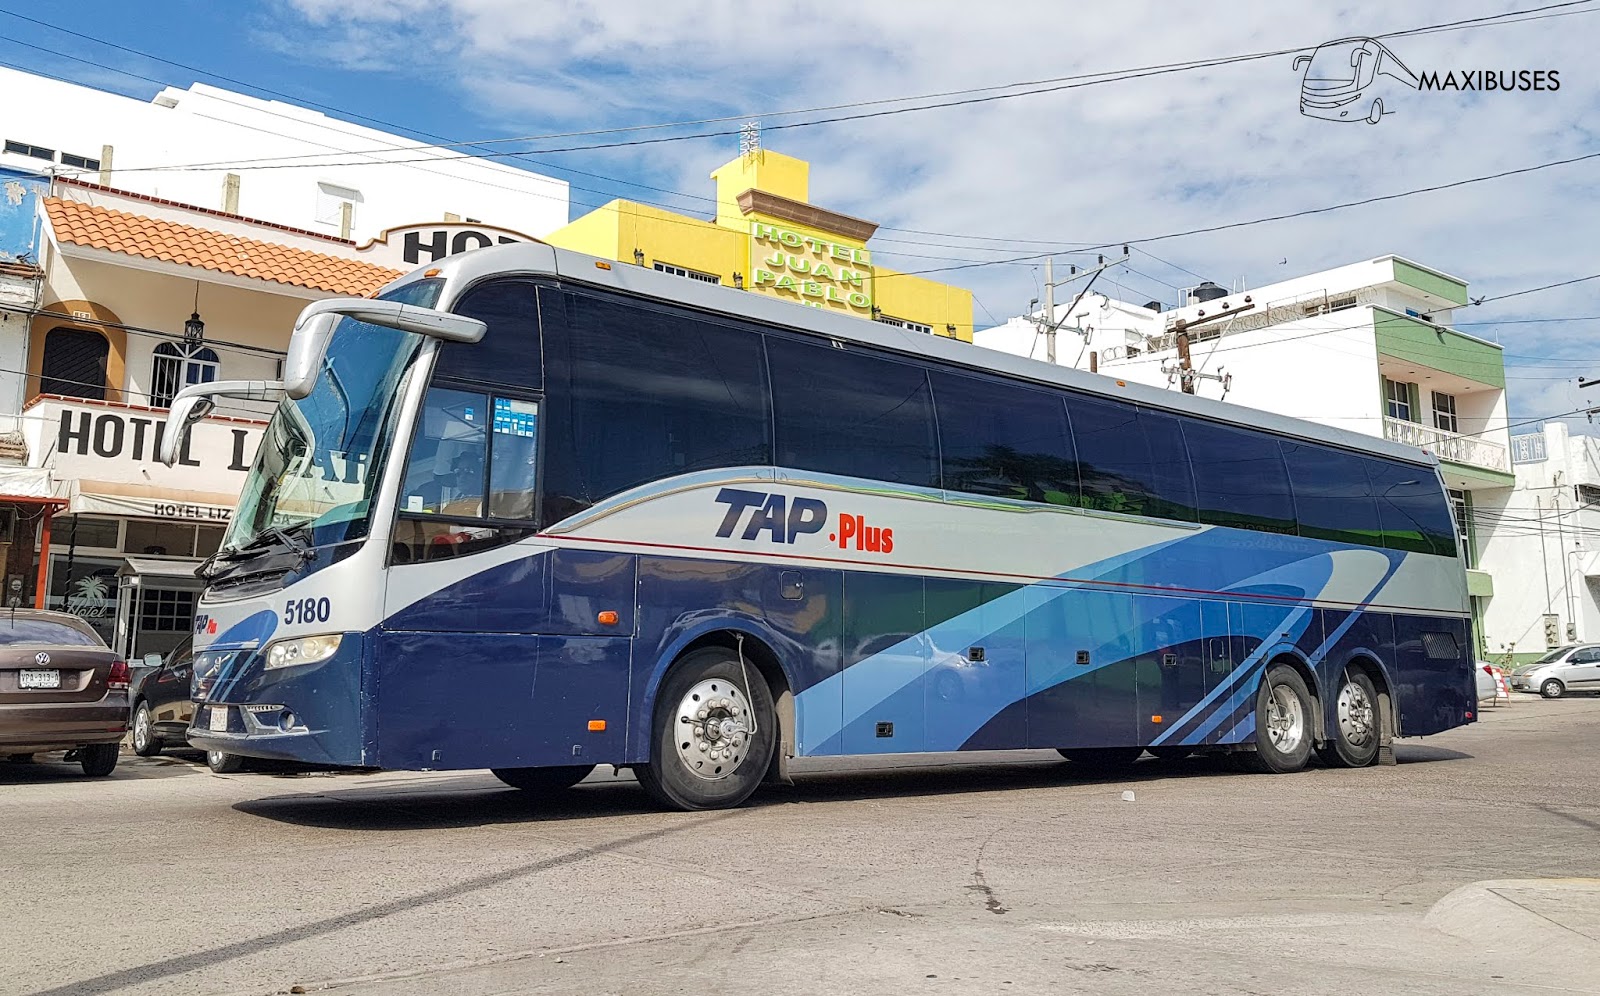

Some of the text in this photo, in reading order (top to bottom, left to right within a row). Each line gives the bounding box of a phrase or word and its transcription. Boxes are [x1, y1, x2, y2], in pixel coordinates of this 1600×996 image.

[754, 223, 870, 266] HOTEL
[765, 252, 862, 286] JUAN
[754, 268, 870, 307] PABLO
[154, 504, 203, 518] HOTEL
[715, 488, 827, 544] TAP
[284, 597, 330, 625] 5180
